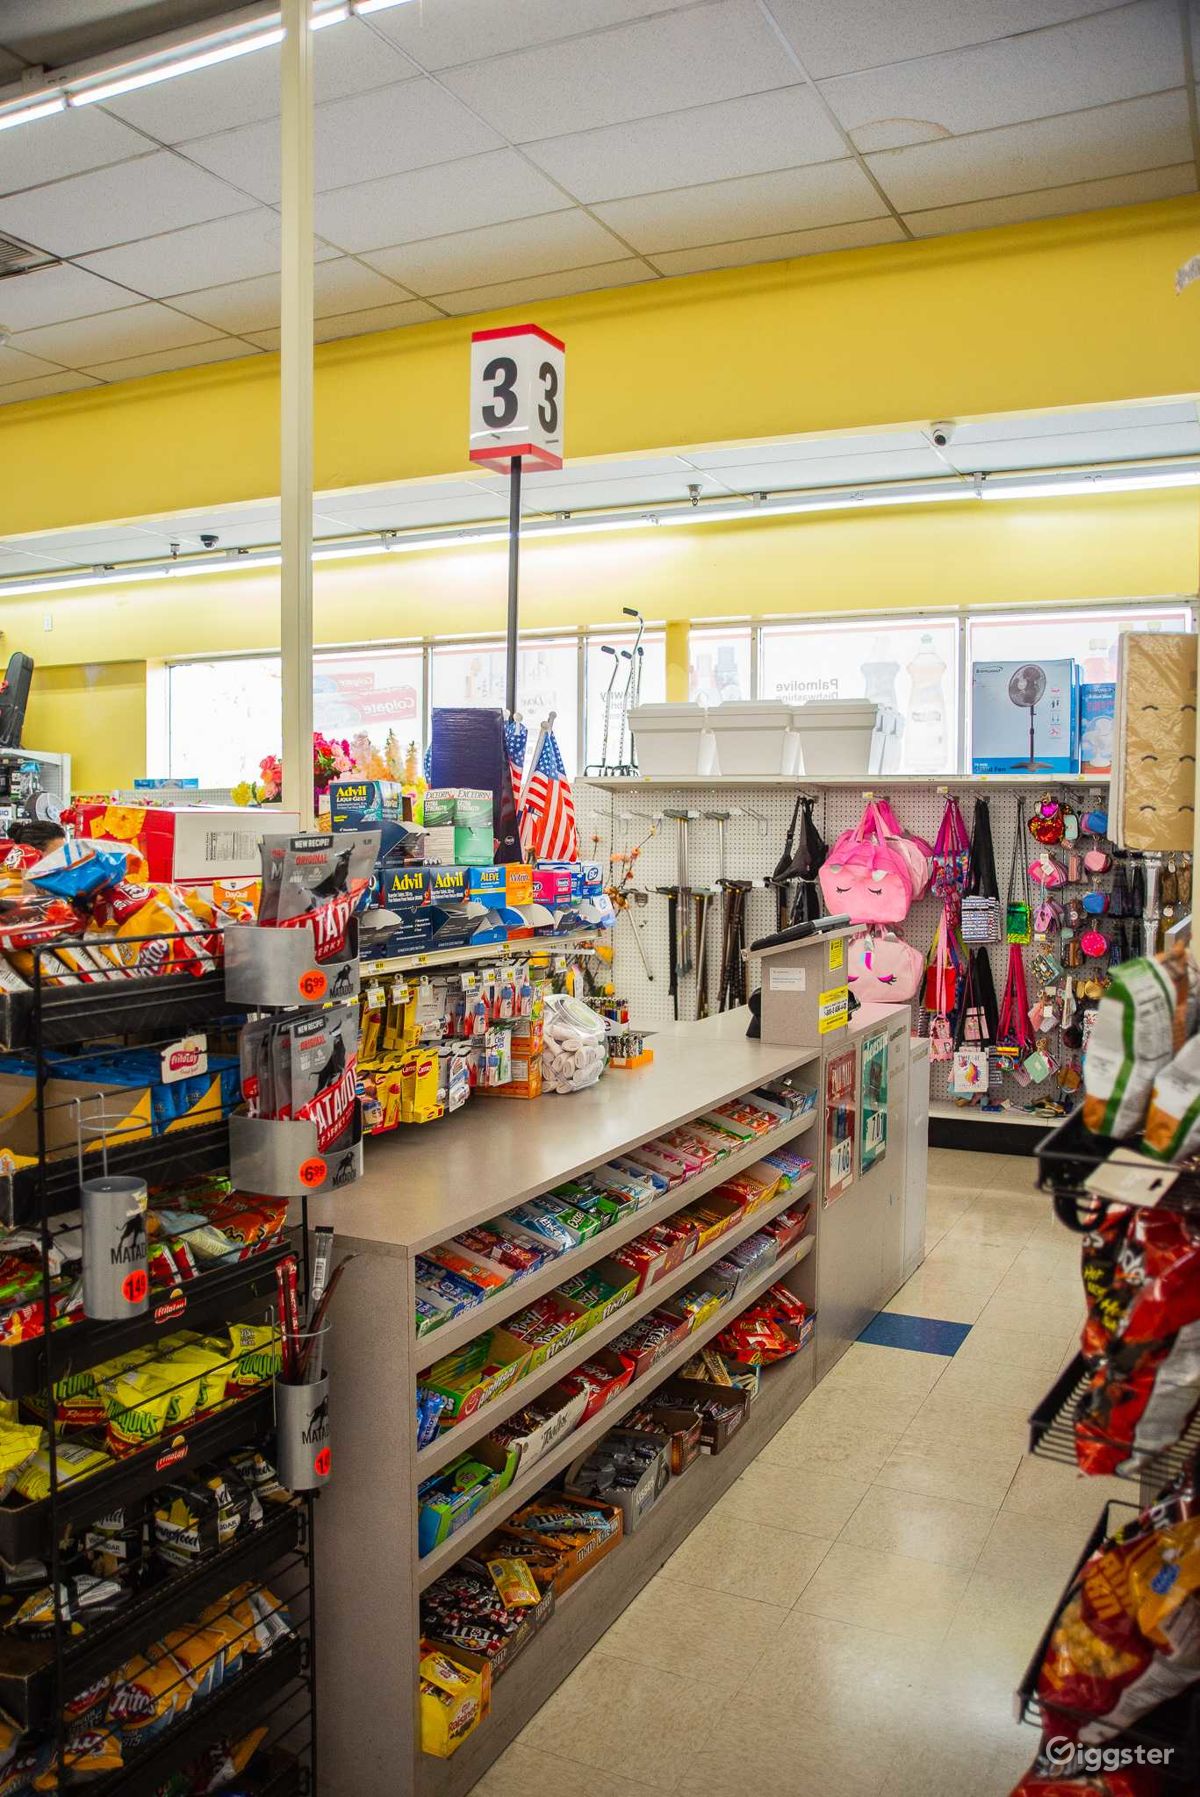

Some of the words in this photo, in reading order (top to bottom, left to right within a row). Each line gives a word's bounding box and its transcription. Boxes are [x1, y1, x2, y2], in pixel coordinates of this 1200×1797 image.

[482, 357, 519, 429] 3
[538, 361, 559, 434] 3
[336, 785, 368, 797] Advil
[295, 840, 307, 849] NEW
[392, 873, 424, 891] Advil
[435, 871, 464, 889] Advil
[480, 872, 499, 882] ALEVE
